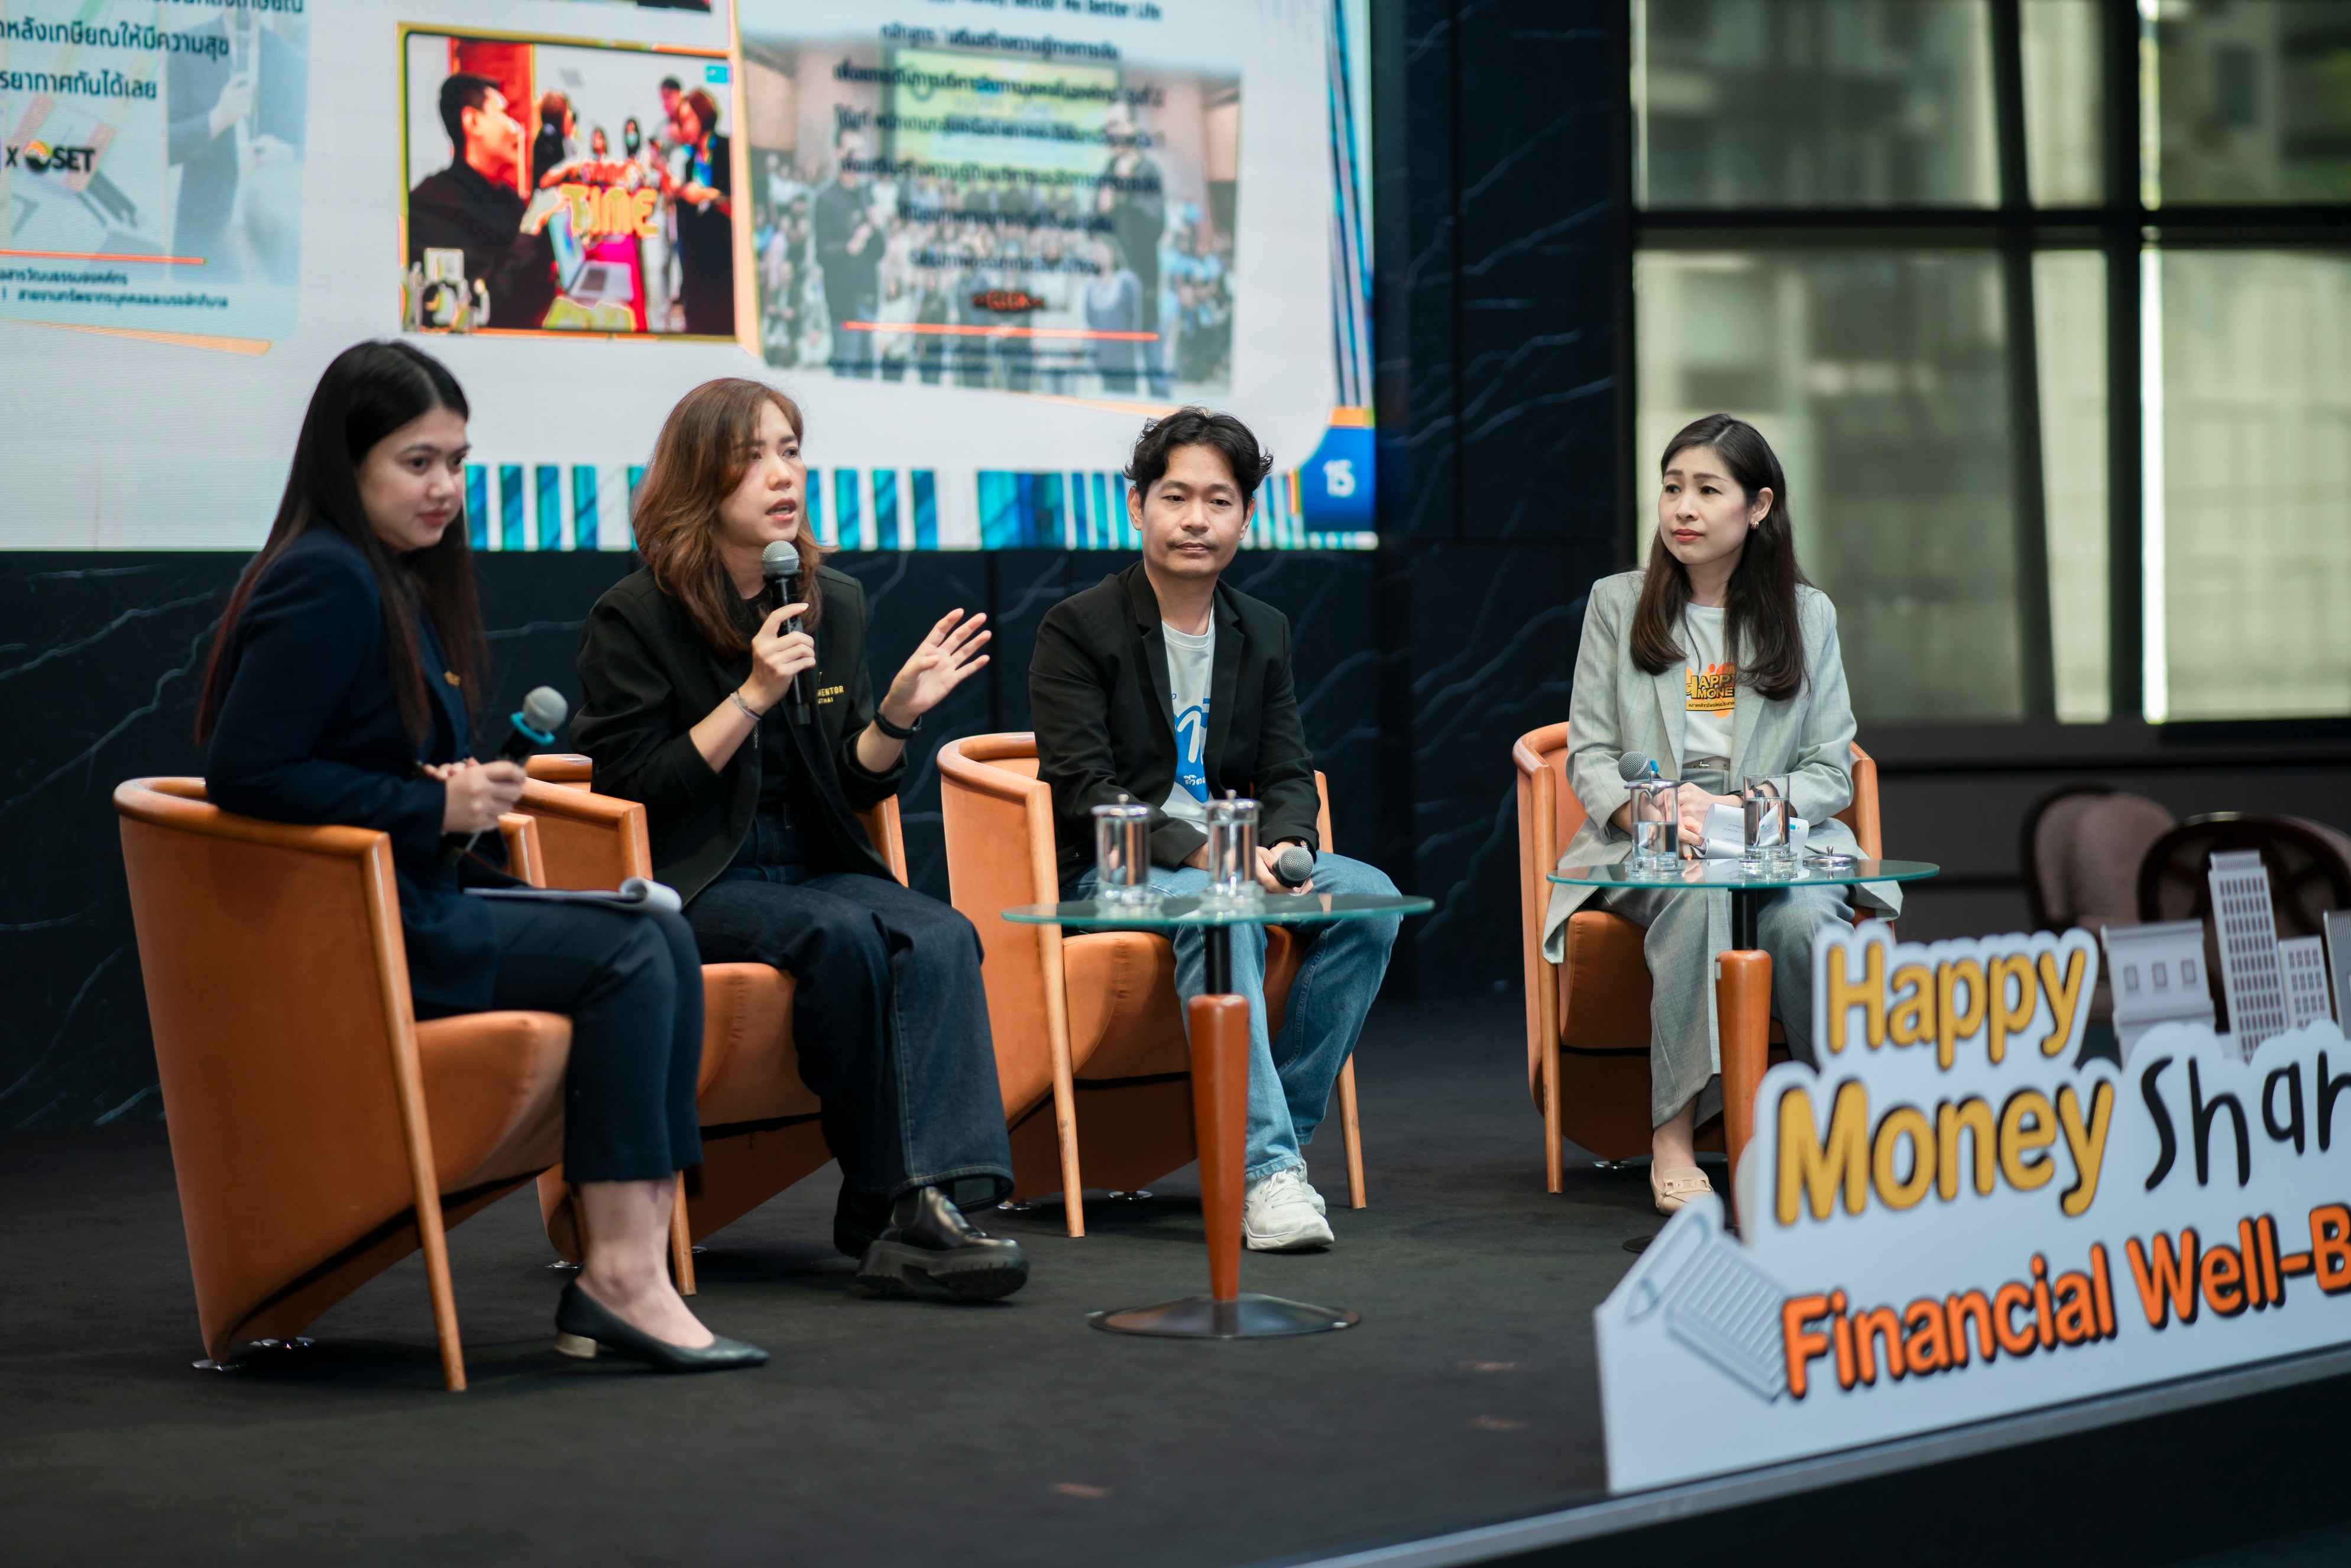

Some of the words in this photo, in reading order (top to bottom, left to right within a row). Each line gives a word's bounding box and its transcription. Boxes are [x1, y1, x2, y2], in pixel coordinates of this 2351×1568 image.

[52, 145, 95, 172] SET
[1323, 459, 1355, 497] 15
[1826, 940, 2087, 1069] Happy
[1774, 1077, 2115, 1227] Money
[2140, 1049, 2351, 1191] Shar
[1781, 1242, 2117, 1399] Financial
[2125, 1203, 2351, 1330] Well-B
